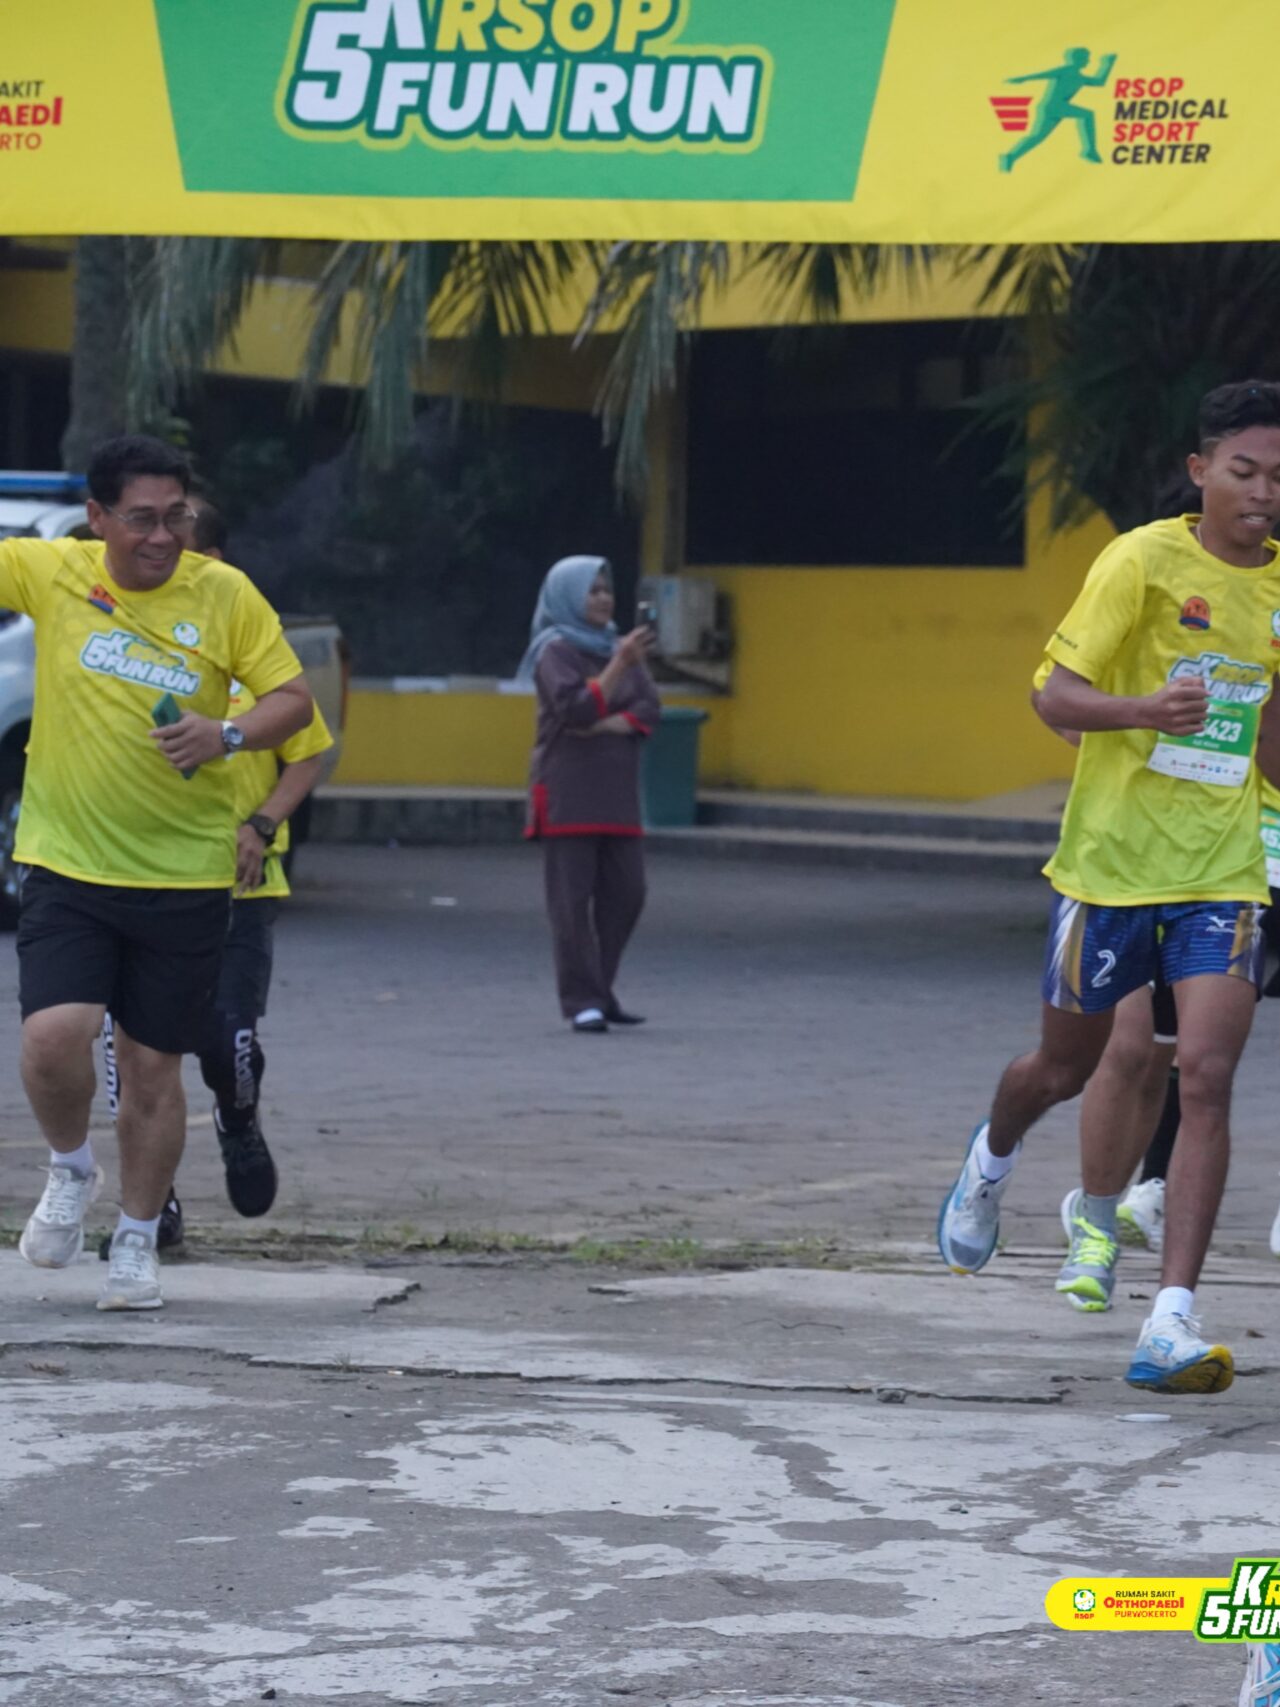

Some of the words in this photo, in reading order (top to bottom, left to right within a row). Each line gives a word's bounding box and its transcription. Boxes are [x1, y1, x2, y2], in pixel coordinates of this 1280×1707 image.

[373, 61, 557, 132] FUN
[567, 63, 756, 135] RUN
[1114, 78, 1184, 98] RSOP
[1115, 99, 1229, 120] MEDICAL
[1113, 122, 1200, 142] SPORT
[1112, 144, 1211, 165] CENTER
[104, 655, 152, 681] FUN
[149, 664, 198, 694] RUN
[1091, 949, 1116, 988] 2
